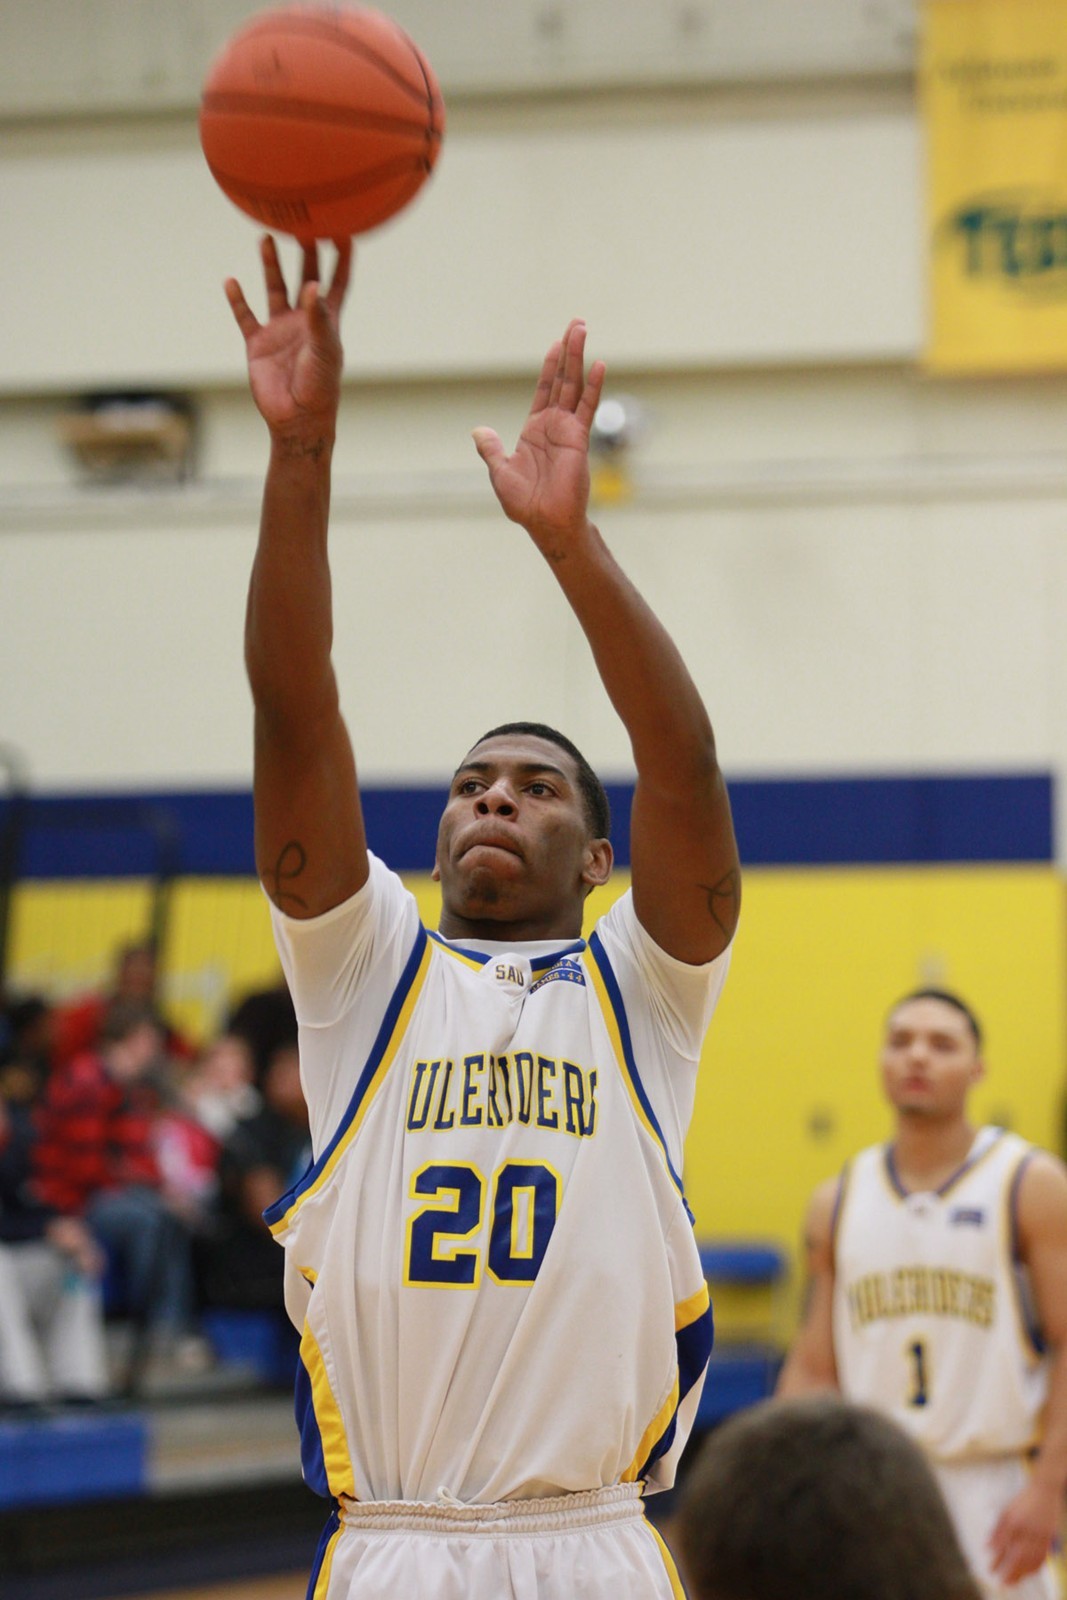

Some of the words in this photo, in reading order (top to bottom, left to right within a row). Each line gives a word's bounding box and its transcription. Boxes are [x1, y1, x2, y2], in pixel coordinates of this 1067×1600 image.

[495, 964, 525, 987] SAU
[402, 1157, 563, 1290] 20
[905, 1336, 930, 1410] 1
